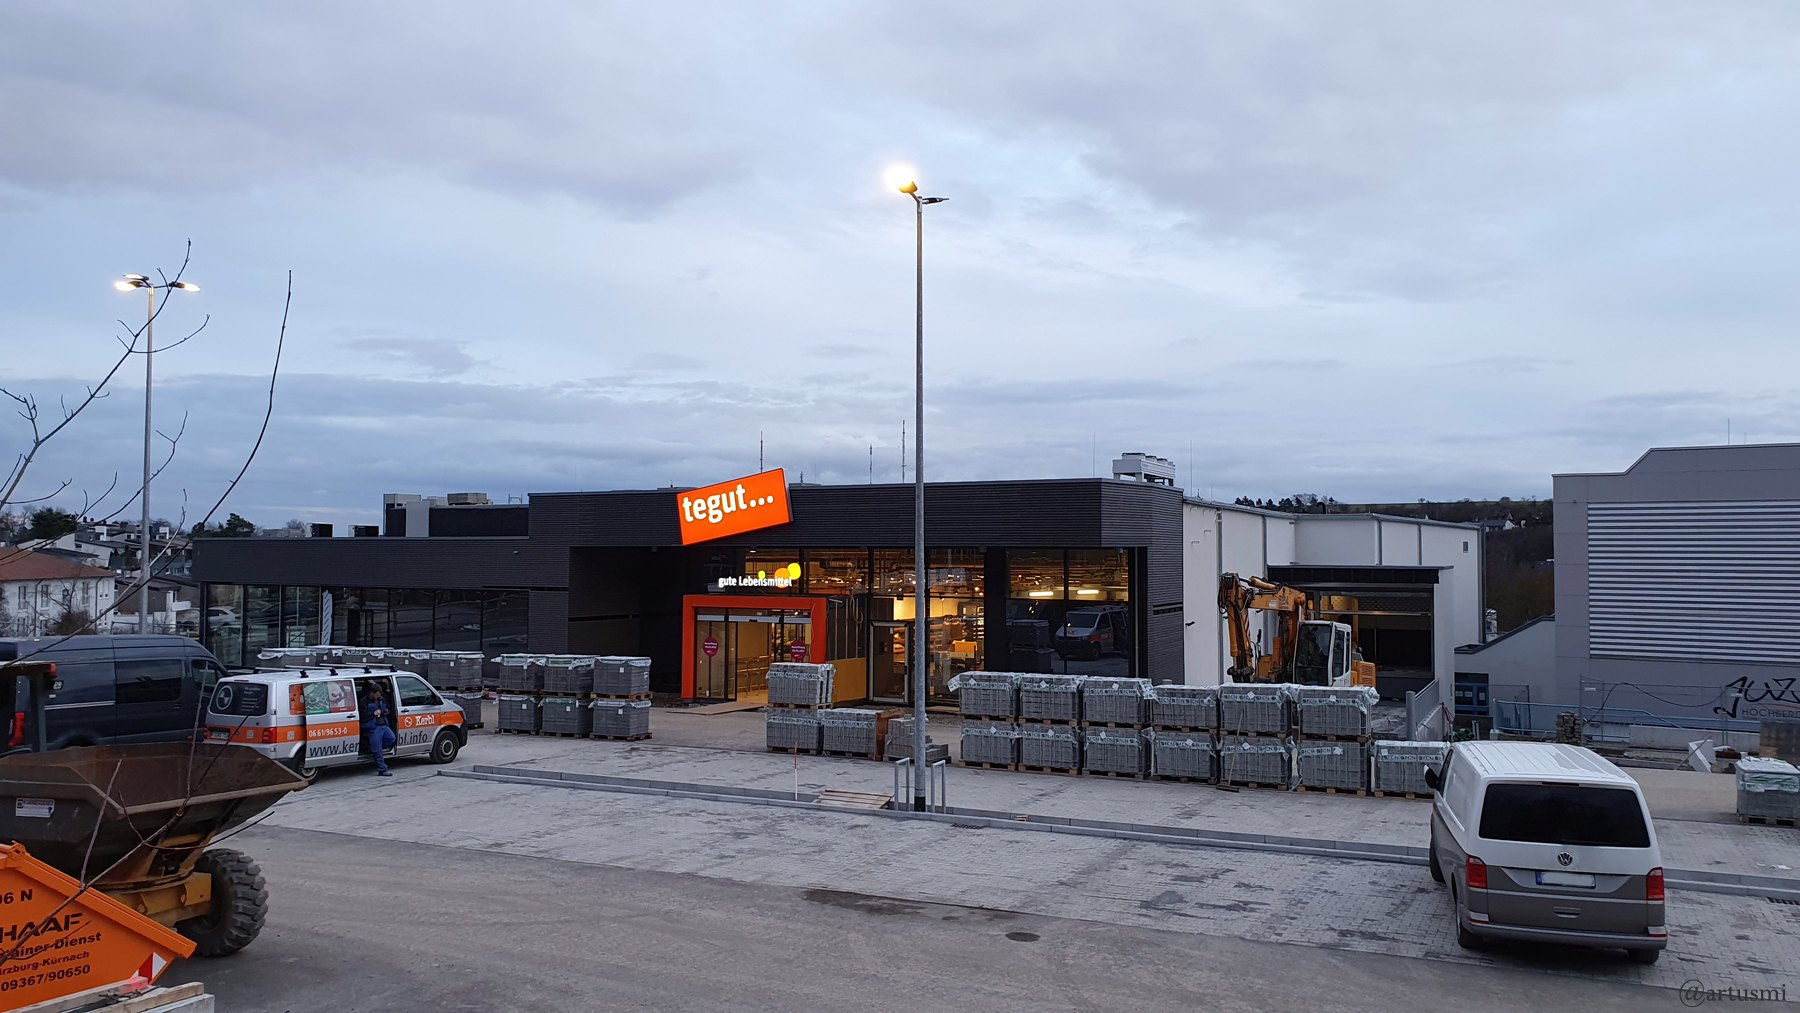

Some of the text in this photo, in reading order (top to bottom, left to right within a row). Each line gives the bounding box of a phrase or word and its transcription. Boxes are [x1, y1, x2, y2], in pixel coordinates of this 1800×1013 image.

[682, 484, 774, 524] tegut...
[718, 576, 793, 588] gute Lebensmittel
[415, 714, 435, 726] Kerbl
[20, 889, 33, 902] N
[1, 965, 90, 991] 09367/90650
